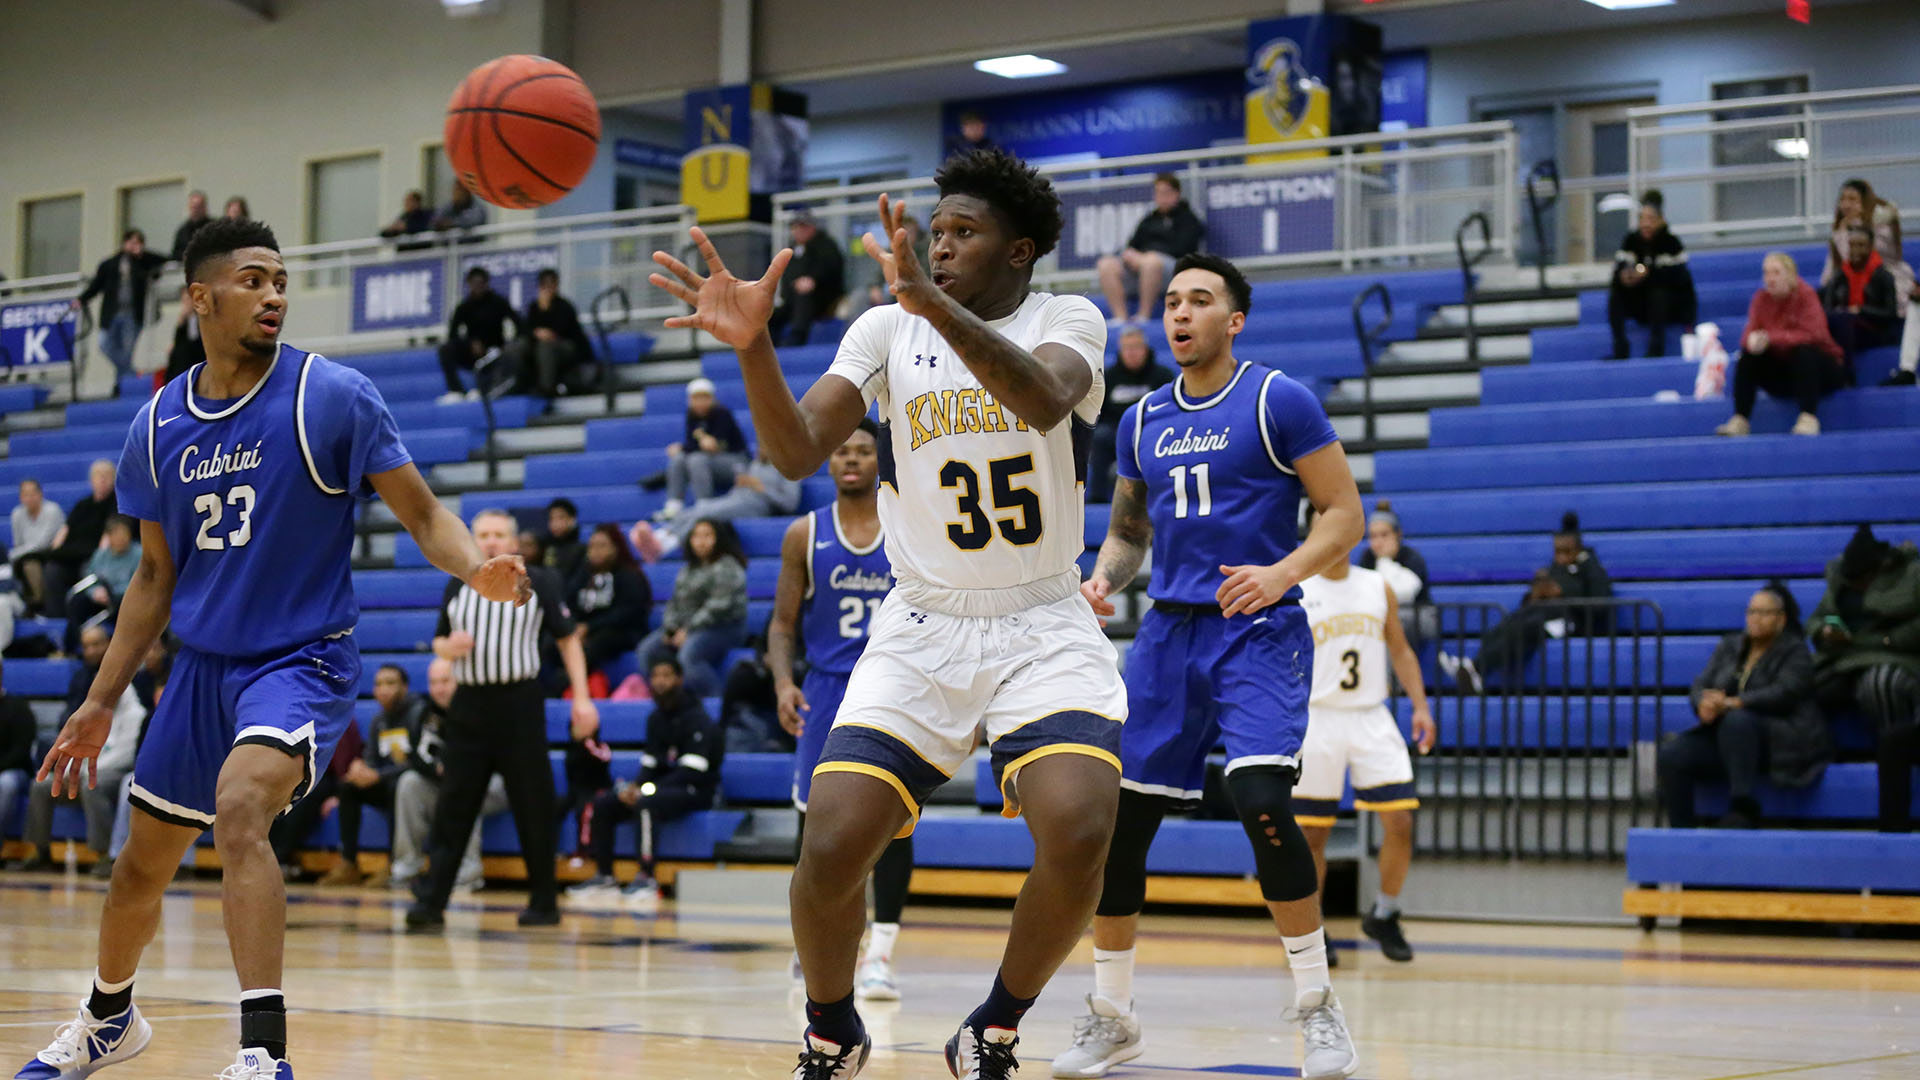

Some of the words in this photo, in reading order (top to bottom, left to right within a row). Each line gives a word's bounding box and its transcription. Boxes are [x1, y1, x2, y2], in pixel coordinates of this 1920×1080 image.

[702, 104, 733, 145] N
[702, 153, 731, 193] U
[1209, 176, 1337, 208] SECTION
[1074, 202, 1153, 258] HOM
[23, 326, 50, 364] K
[904, 387, 1047, 452] KNIGH
[179, 439, 263, 484] Cabrini
[1154, 426, 1231, 459] Cabrini
[938, 451, 1045, 552] 35
[1168, 462, 1212, 519] 11
[193, 484, 256, 551] 23
[829, 563, 892, 592] Cabrini
[1340, 648, 1361, 692] 3
